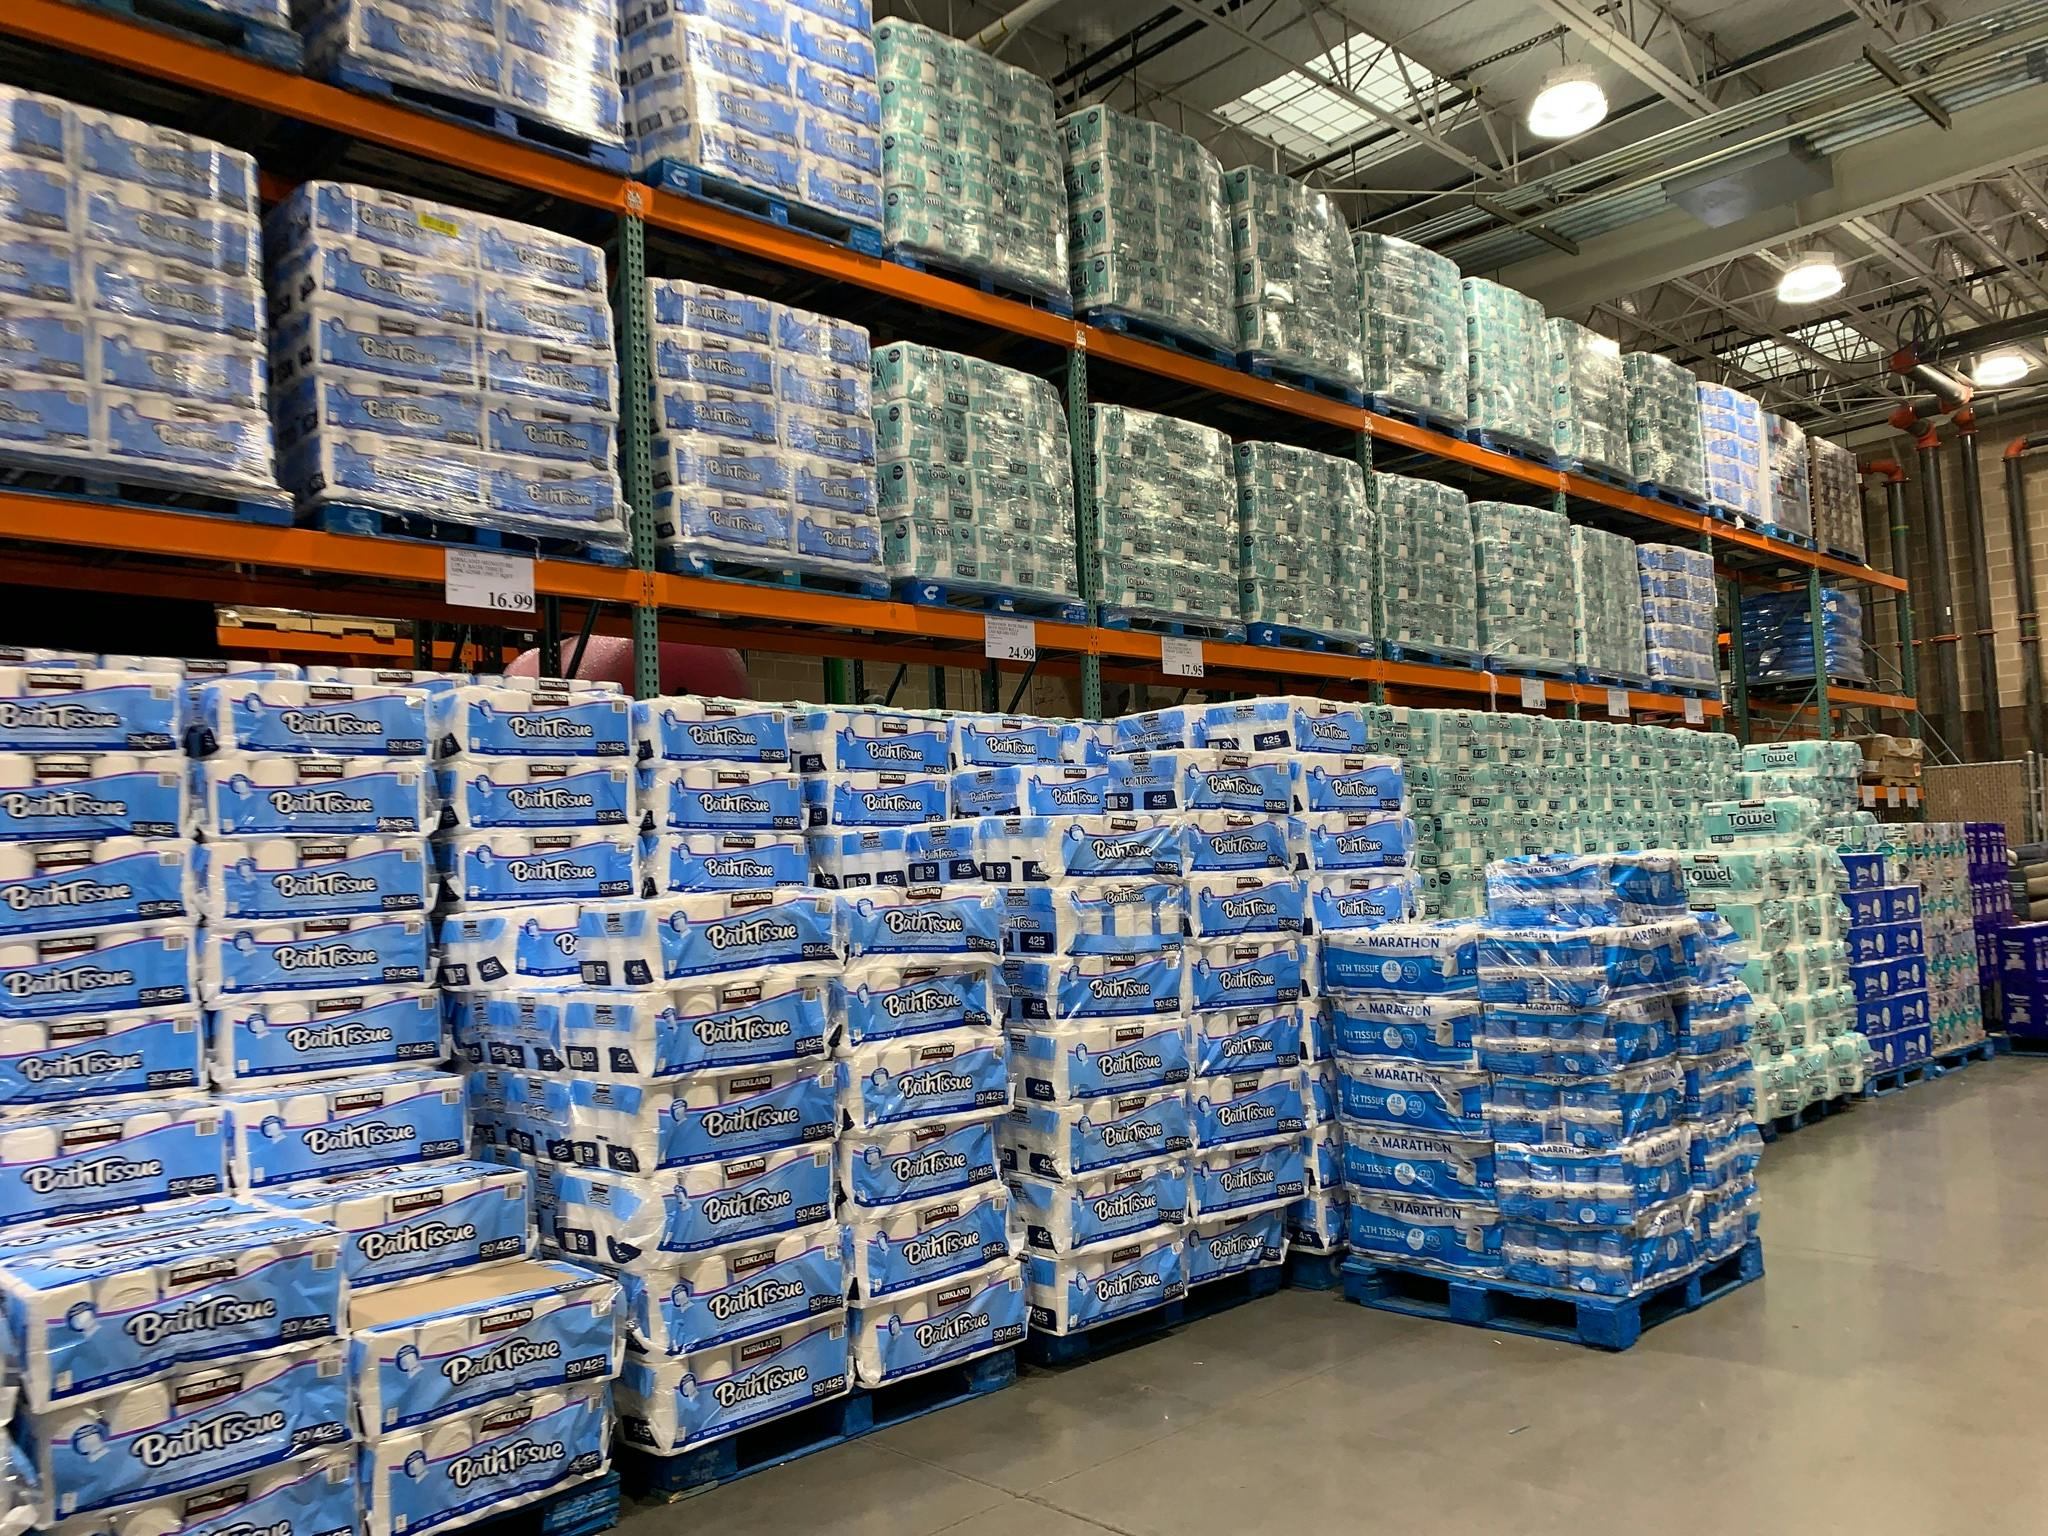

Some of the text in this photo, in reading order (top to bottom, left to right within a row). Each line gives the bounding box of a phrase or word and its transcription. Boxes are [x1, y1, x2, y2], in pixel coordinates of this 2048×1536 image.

[489, 592, 532, 609] 16.99
[1008, 647, 1034, 659] 24.99
[1182, 664, 1203, 675] 17.95
[1222, 735, 1280, 749] 30 425
[1761, 752, 1798, 764] Towel
[1119, 795, 1167, 804] 30 425
[1728, 812, 1778, 827] Towel
[957, 864, 971, 873] 425
[1528, 864, 1569, 874] MARATHON
[883, 875, 898, 883] 425
[1684, 868, 1732, 882] Towel
[1028, 936, 1045, 945] 425
[1369, 937, 1439, 948] MARATHON
[1354, 964, 1378, 973] TISSUE
[1369, 1005, 1430, 1015] MARATHON
[1375, 1068, 1441, 1084] MARATHON
[1035, 1084, 1049, 1093] 425
[1361, 1096, 1384, 1105] TISSUE
[1382, 1138, 1451, 1154] MARATHON
[1538, 1145, 1589, 1155] MARATHON
[1367, 1165, 1392, 1175] TISSUE
[1394, 1203, 1461, 1219] MARATHON
[1379, 1226, 1405, 1238] TISSUE
[578, 1234, 588, 1245] 30
